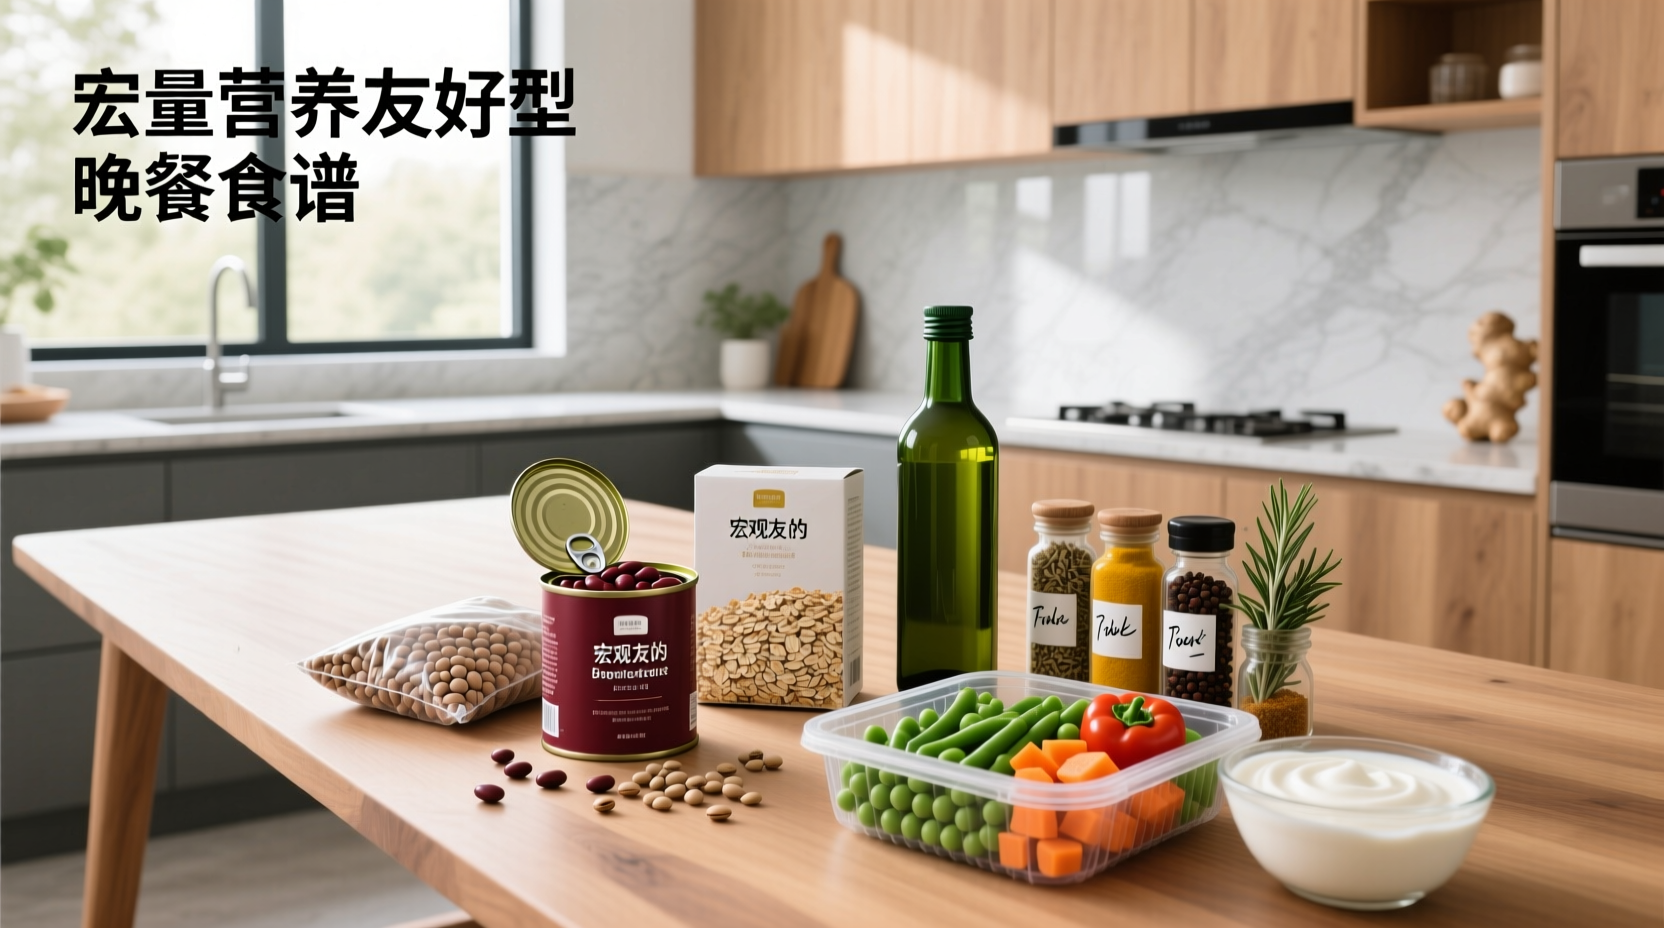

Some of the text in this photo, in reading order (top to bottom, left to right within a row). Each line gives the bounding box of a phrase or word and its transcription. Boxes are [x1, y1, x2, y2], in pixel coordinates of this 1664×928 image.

[730, 517, 808, 540] 宏观友的
[593, 641, 668, 665] 宏观友的
